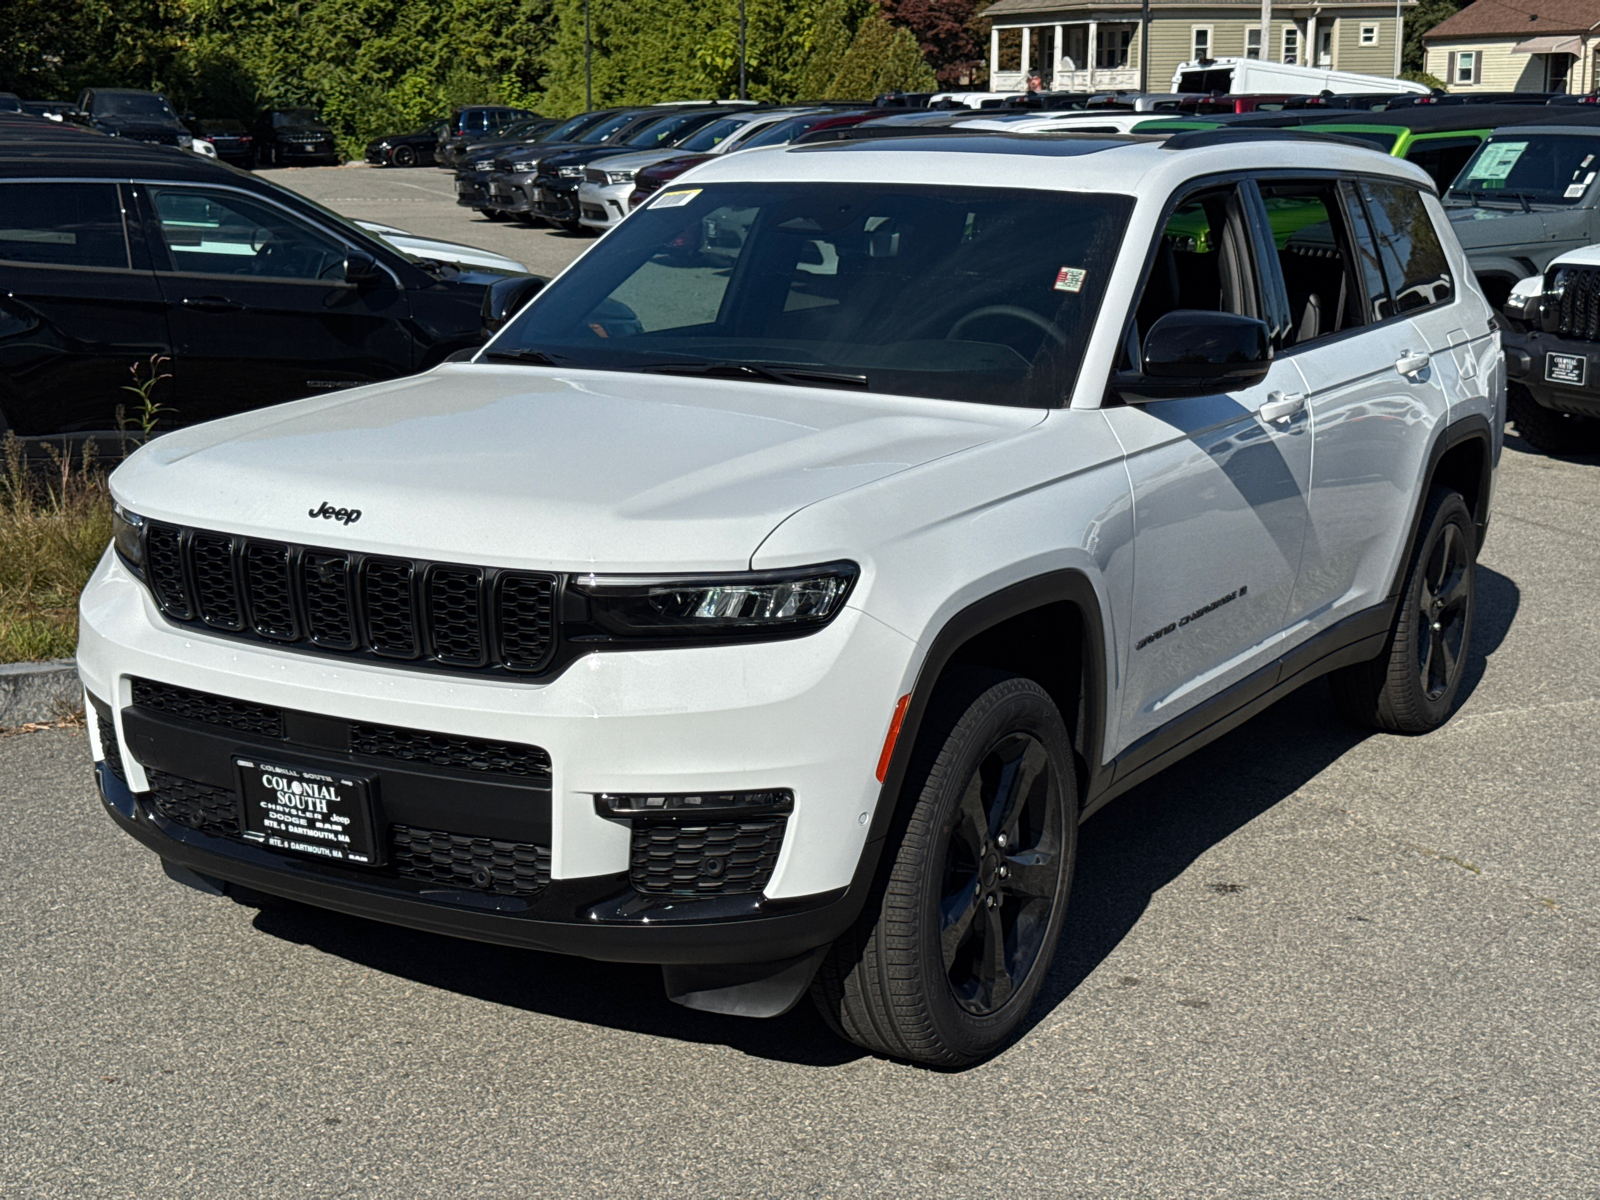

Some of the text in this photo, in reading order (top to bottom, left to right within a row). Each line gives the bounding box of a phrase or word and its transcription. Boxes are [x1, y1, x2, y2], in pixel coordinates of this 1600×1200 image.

[308, 501, 362, 526] Jeep
[1135, 622, 1177, 650] GRAND
[1178, 591, 1238, 627] CHEROKEE
[260, 764, 333, 782] COLONIAL SOUTH
[262, 774, 341, 801] COLONIAL
[260, 801, 350, 825] CHRYSLER Jeep
[276, 791, 328, 813] SOUTH
[269, 811, 342, 831] DODGE RAM
[288, 824, 337, 841] DARTMOUTH,
[337, 834, 350, 843] MA
[332, 850, 343, 858] MA
